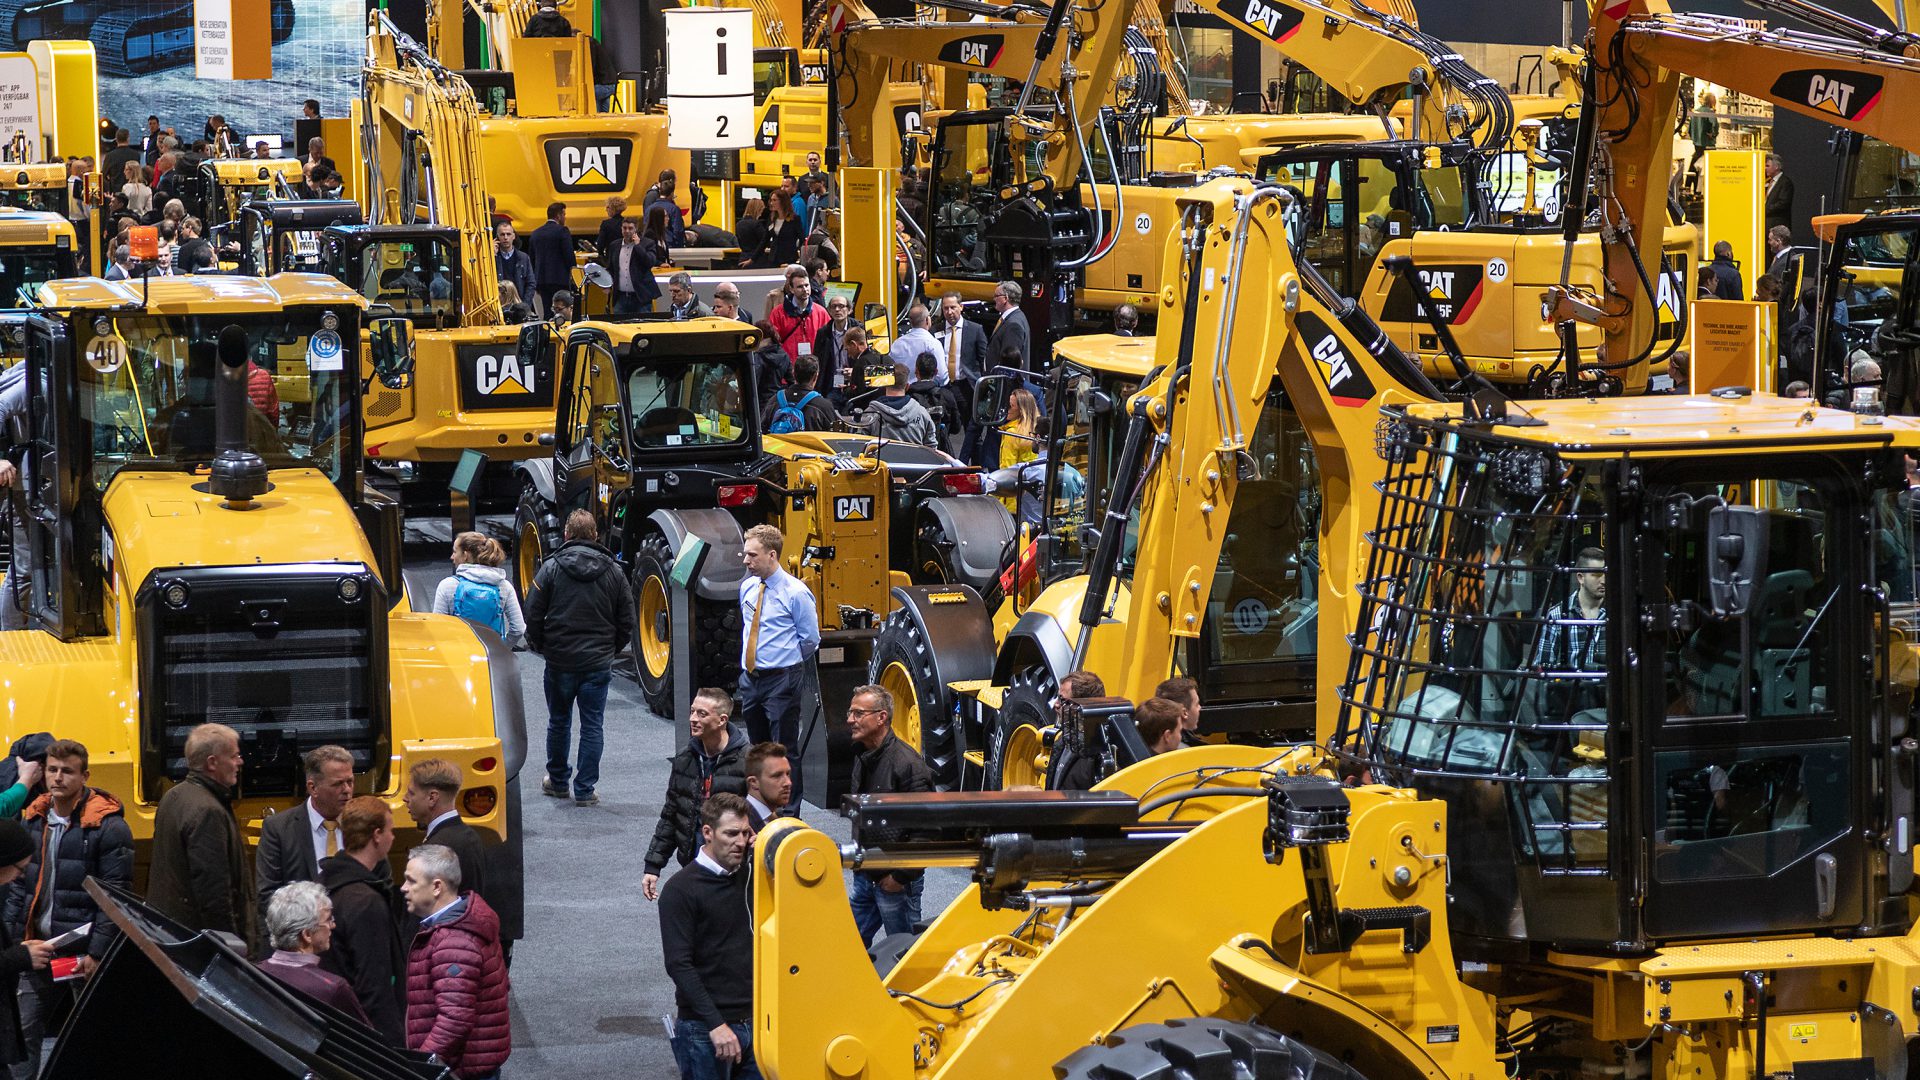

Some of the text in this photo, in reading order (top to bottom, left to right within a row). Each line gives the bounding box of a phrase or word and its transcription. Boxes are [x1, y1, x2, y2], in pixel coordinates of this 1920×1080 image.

[1244, 0, 1282, 36] CAT
[961, 41, 988, 66] CAT
[1808, 74, 1855, 116] CAT
[716, 115, 729, 138] 2
[762, 121, 778, 136] CAT
[560, 146, 621, 185] CAT
[1546, 202, 1557, 216] 20
[1137, 217, 1150, 229] 20
[1489, 263, 1506, 277] 20
[94, 340, 118, 366] 40
[1313, 334, 1353, 390] CAT
[837, 498, 871, 520] CAT
